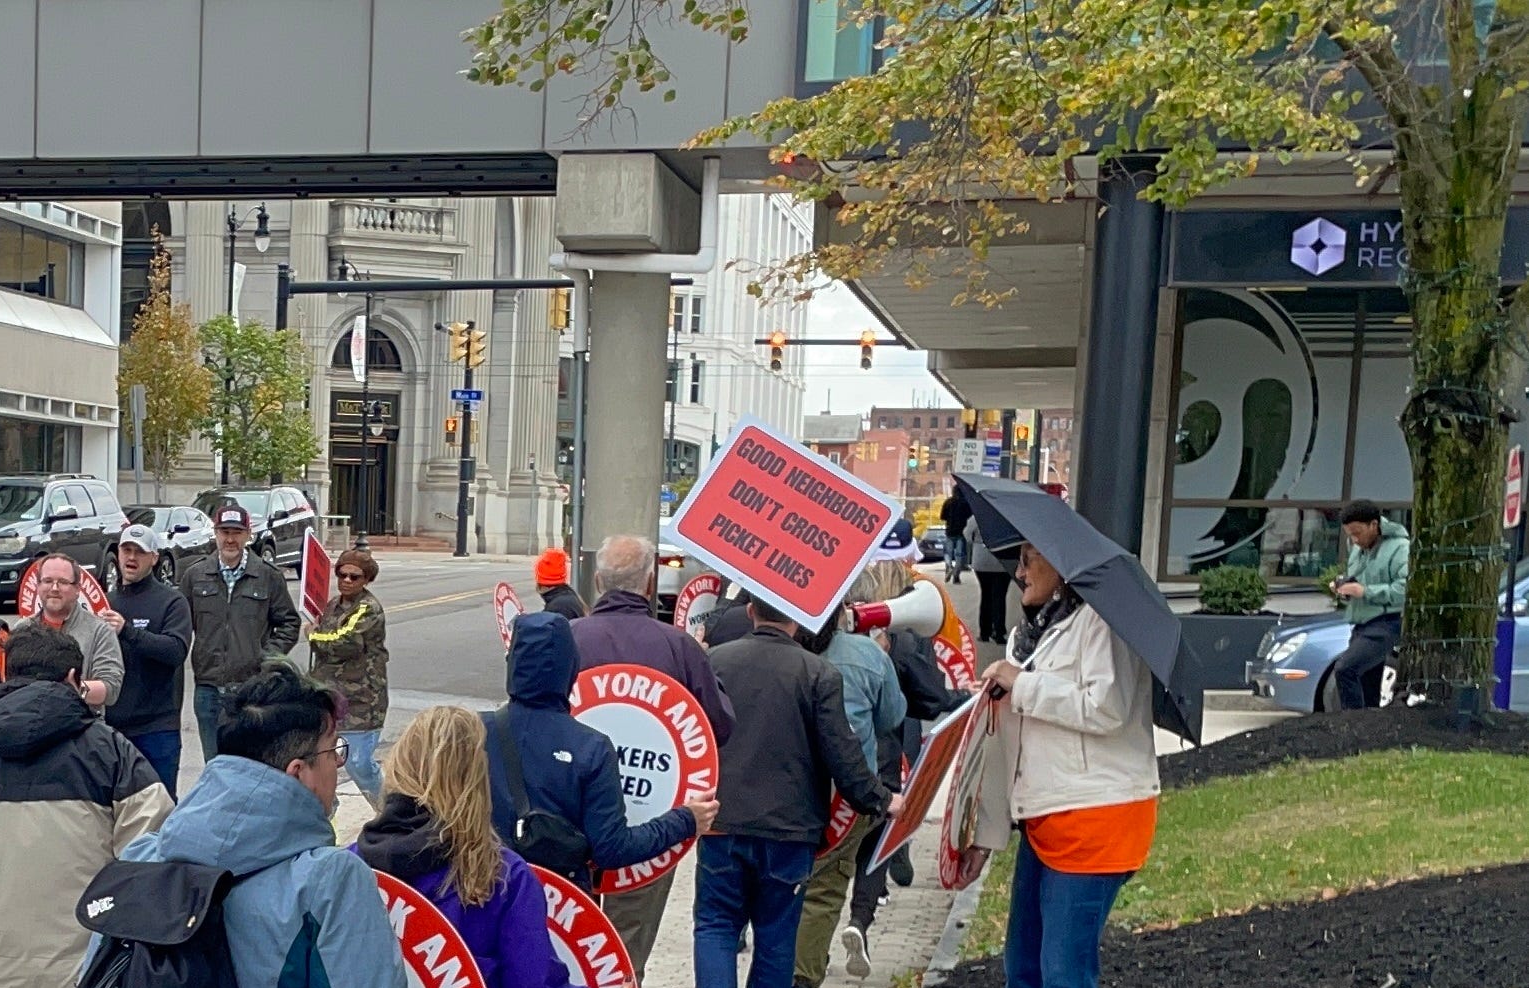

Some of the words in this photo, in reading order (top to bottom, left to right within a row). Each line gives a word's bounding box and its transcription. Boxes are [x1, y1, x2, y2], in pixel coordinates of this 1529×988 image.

[728, 479, 784, 521] DON'T
[780, 512, 841, 558] CROSS
[736, 438, 787, 478] GOOD
[784, 466, 879, 535] NEIGHBORS
[708, 513, 769, 560] PICKET
[765, 548, 815, 589] LINES
[949, 662, 970, 690] AN
[591, 672, 668, 709] YORK
[664, 700, 709, 759] AND
[617, 746, 672, 772] KERS
[543, 883, 585, 934] RK
